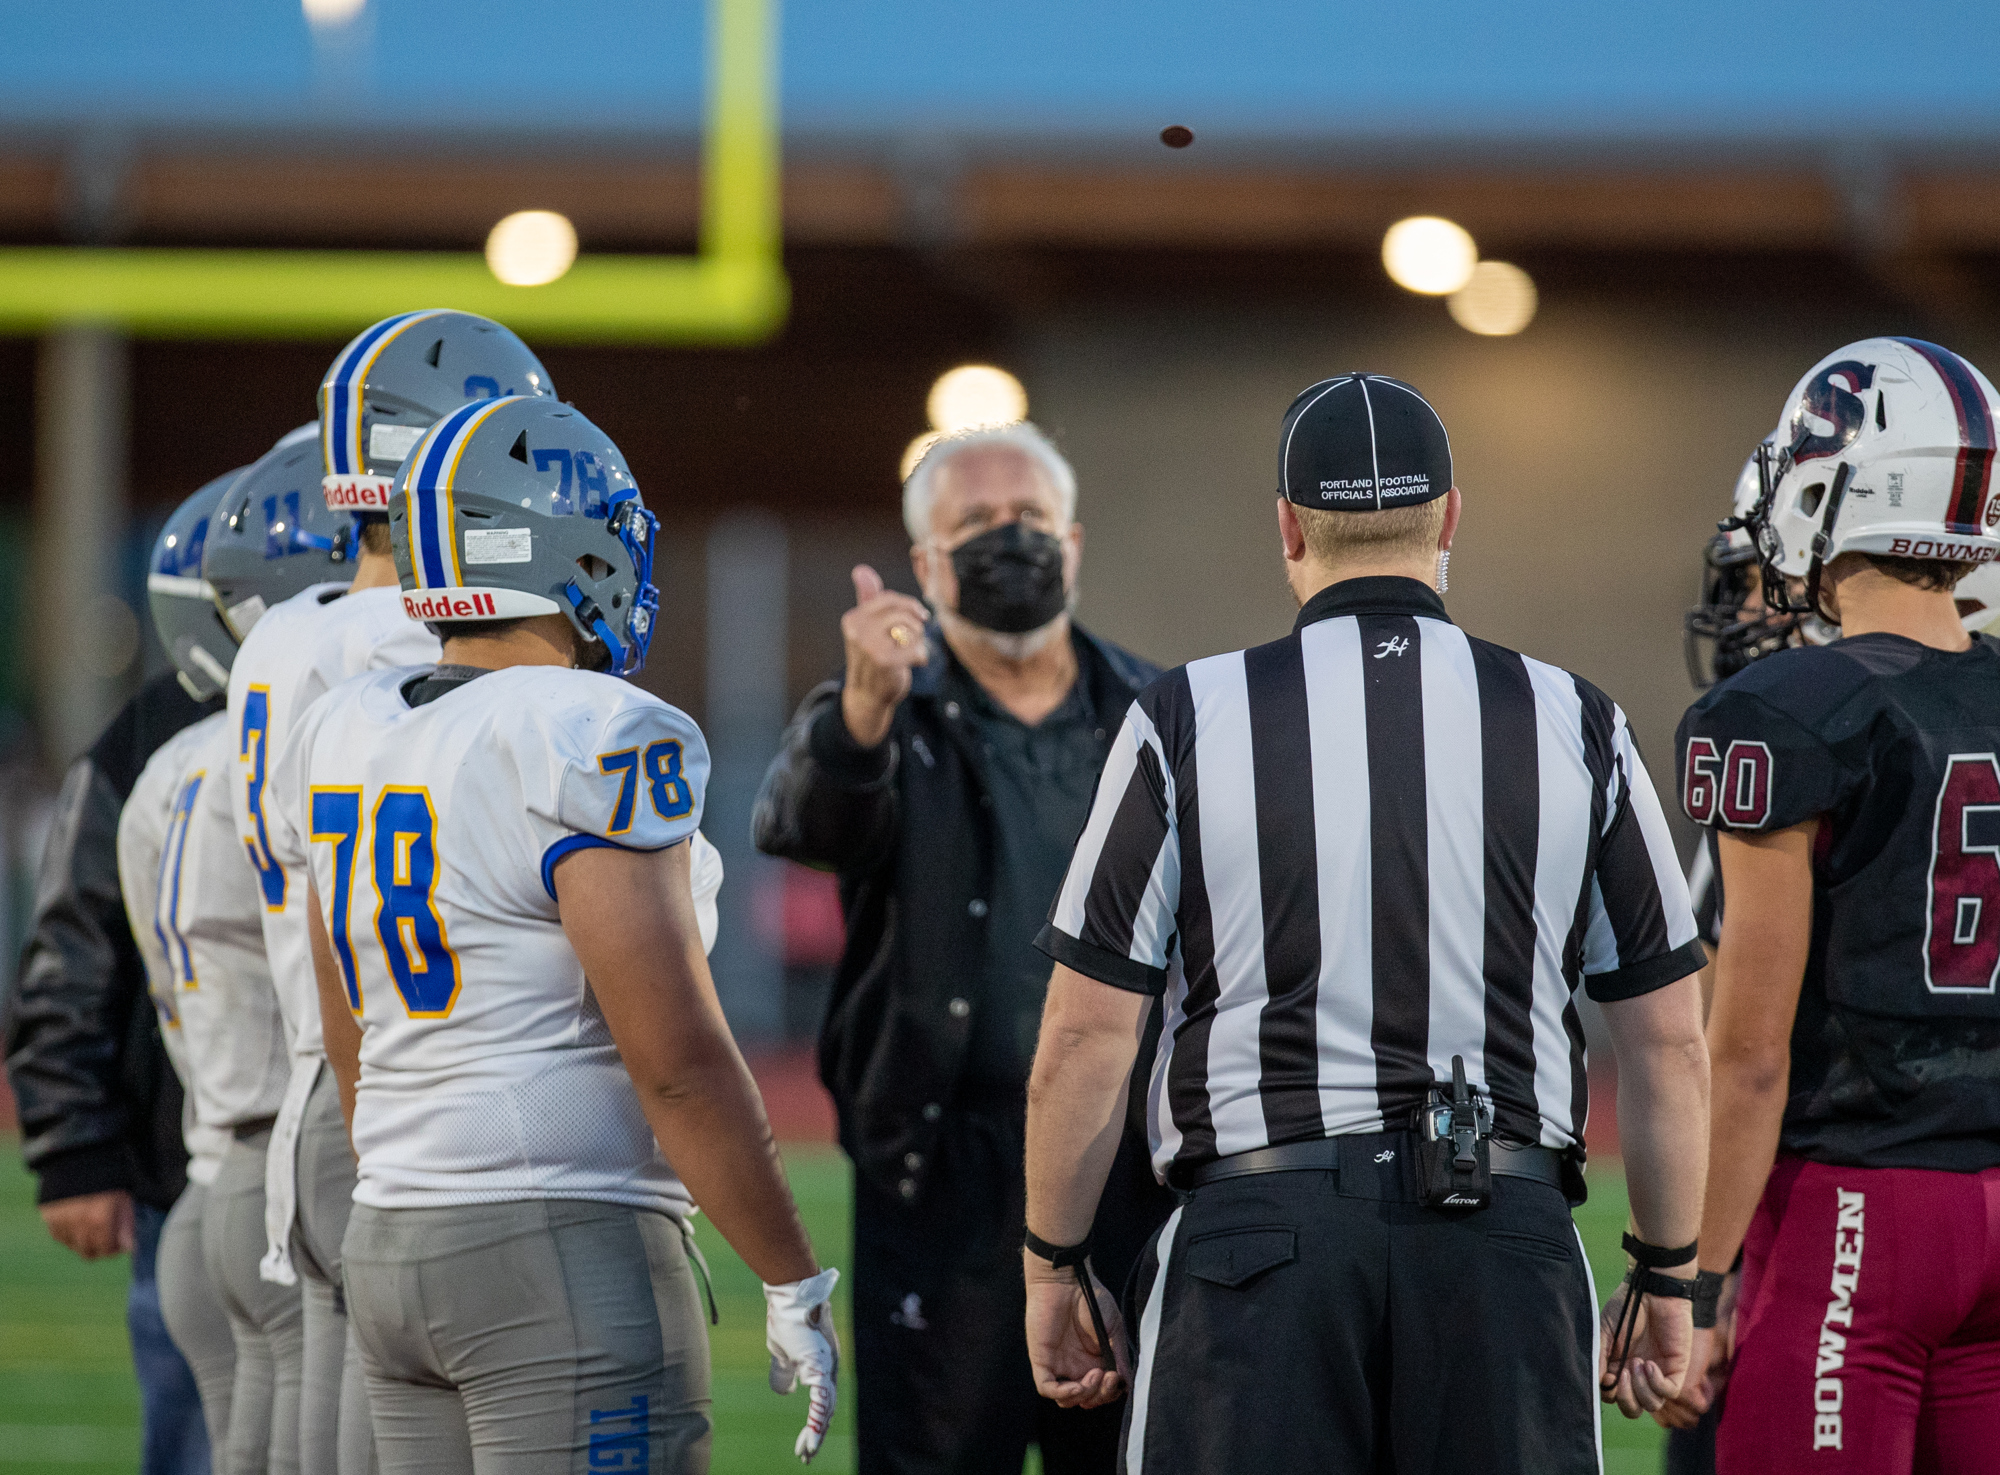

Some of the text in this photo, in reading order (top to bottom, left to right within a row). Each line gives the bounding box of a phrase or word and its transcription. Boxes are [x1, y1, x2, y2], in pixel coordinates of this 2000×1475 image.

[531, 448, 609, 520] 78
[1320, 473, 1430, 490] PORTLAND FOOTBALL
[1321, 484, 1430, 500] OFFICIALS ASSOCIATION
[403, 593, 496, 618] Riddell
[596, 737, 696, 836] 78
[1684, 736, 1773, 829] 60
[309, 784, 462, 1019] 78
[1922, 752, 2000, 995] 6
[1813, 1187, 1865, 1451] BOWMEN
[587, 1394, 650, 1475] TIG
